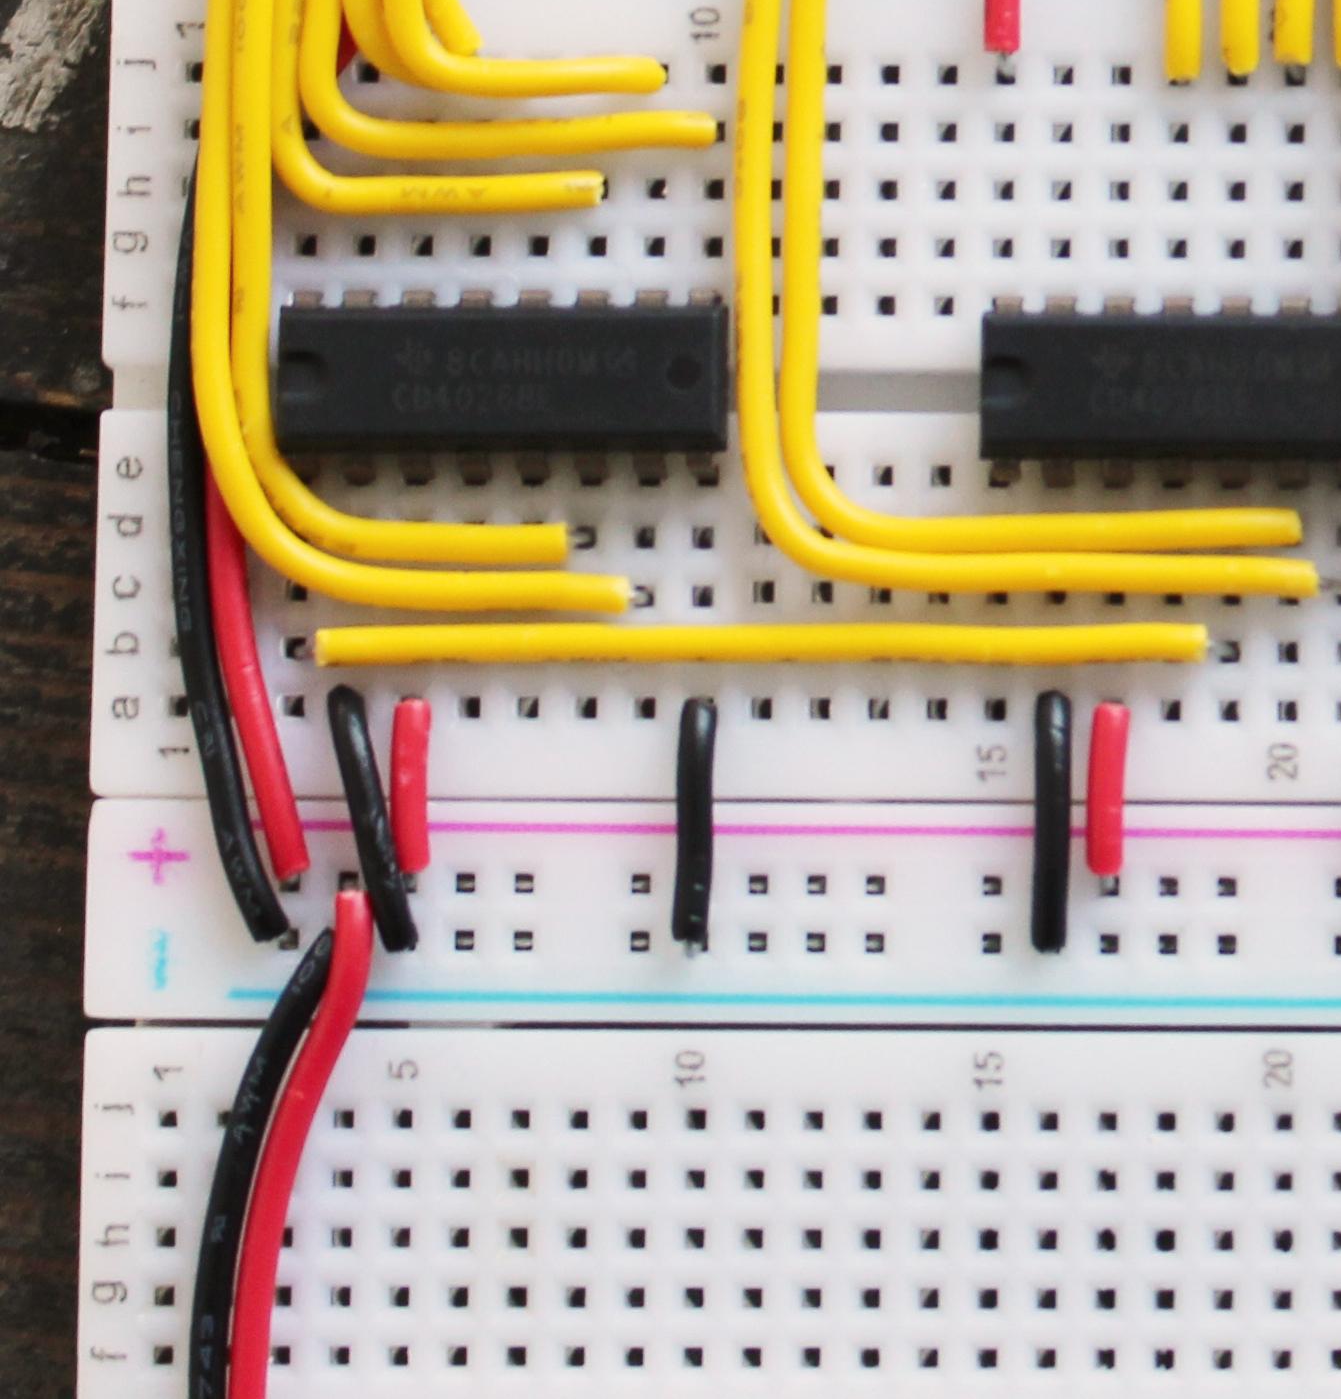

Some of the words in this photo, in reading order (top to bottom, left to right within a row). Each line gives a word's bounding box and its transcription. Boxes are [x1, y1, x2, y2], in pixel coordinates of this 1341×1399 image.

[689, 7, 722, 43] 10
[118, 175, 153, 198] h
[112, 230, 150, 255] g
[115, 456, 145, 482] e
[107, 514, 145, 539] d
[111, 575, 143, 601] c
[105, 630, 141, 657] b
[110, 696, 140, 721] a
[158, 745, 192, 757] 1
[976, 744, 1008, 783] 15
[1265, 742, 1299, 782] 20
[152, 1065, 182, 1082] 1
[387, 1059, 419, 1081] 5
[673, 1050, 706, 1089] 10
[972, 1051, 1004, 1091] 15
[1262, 1049, 1293, 1089] 20
[96, 1224, 130, 1249] h
[91, 1280, 129, 1305] g
